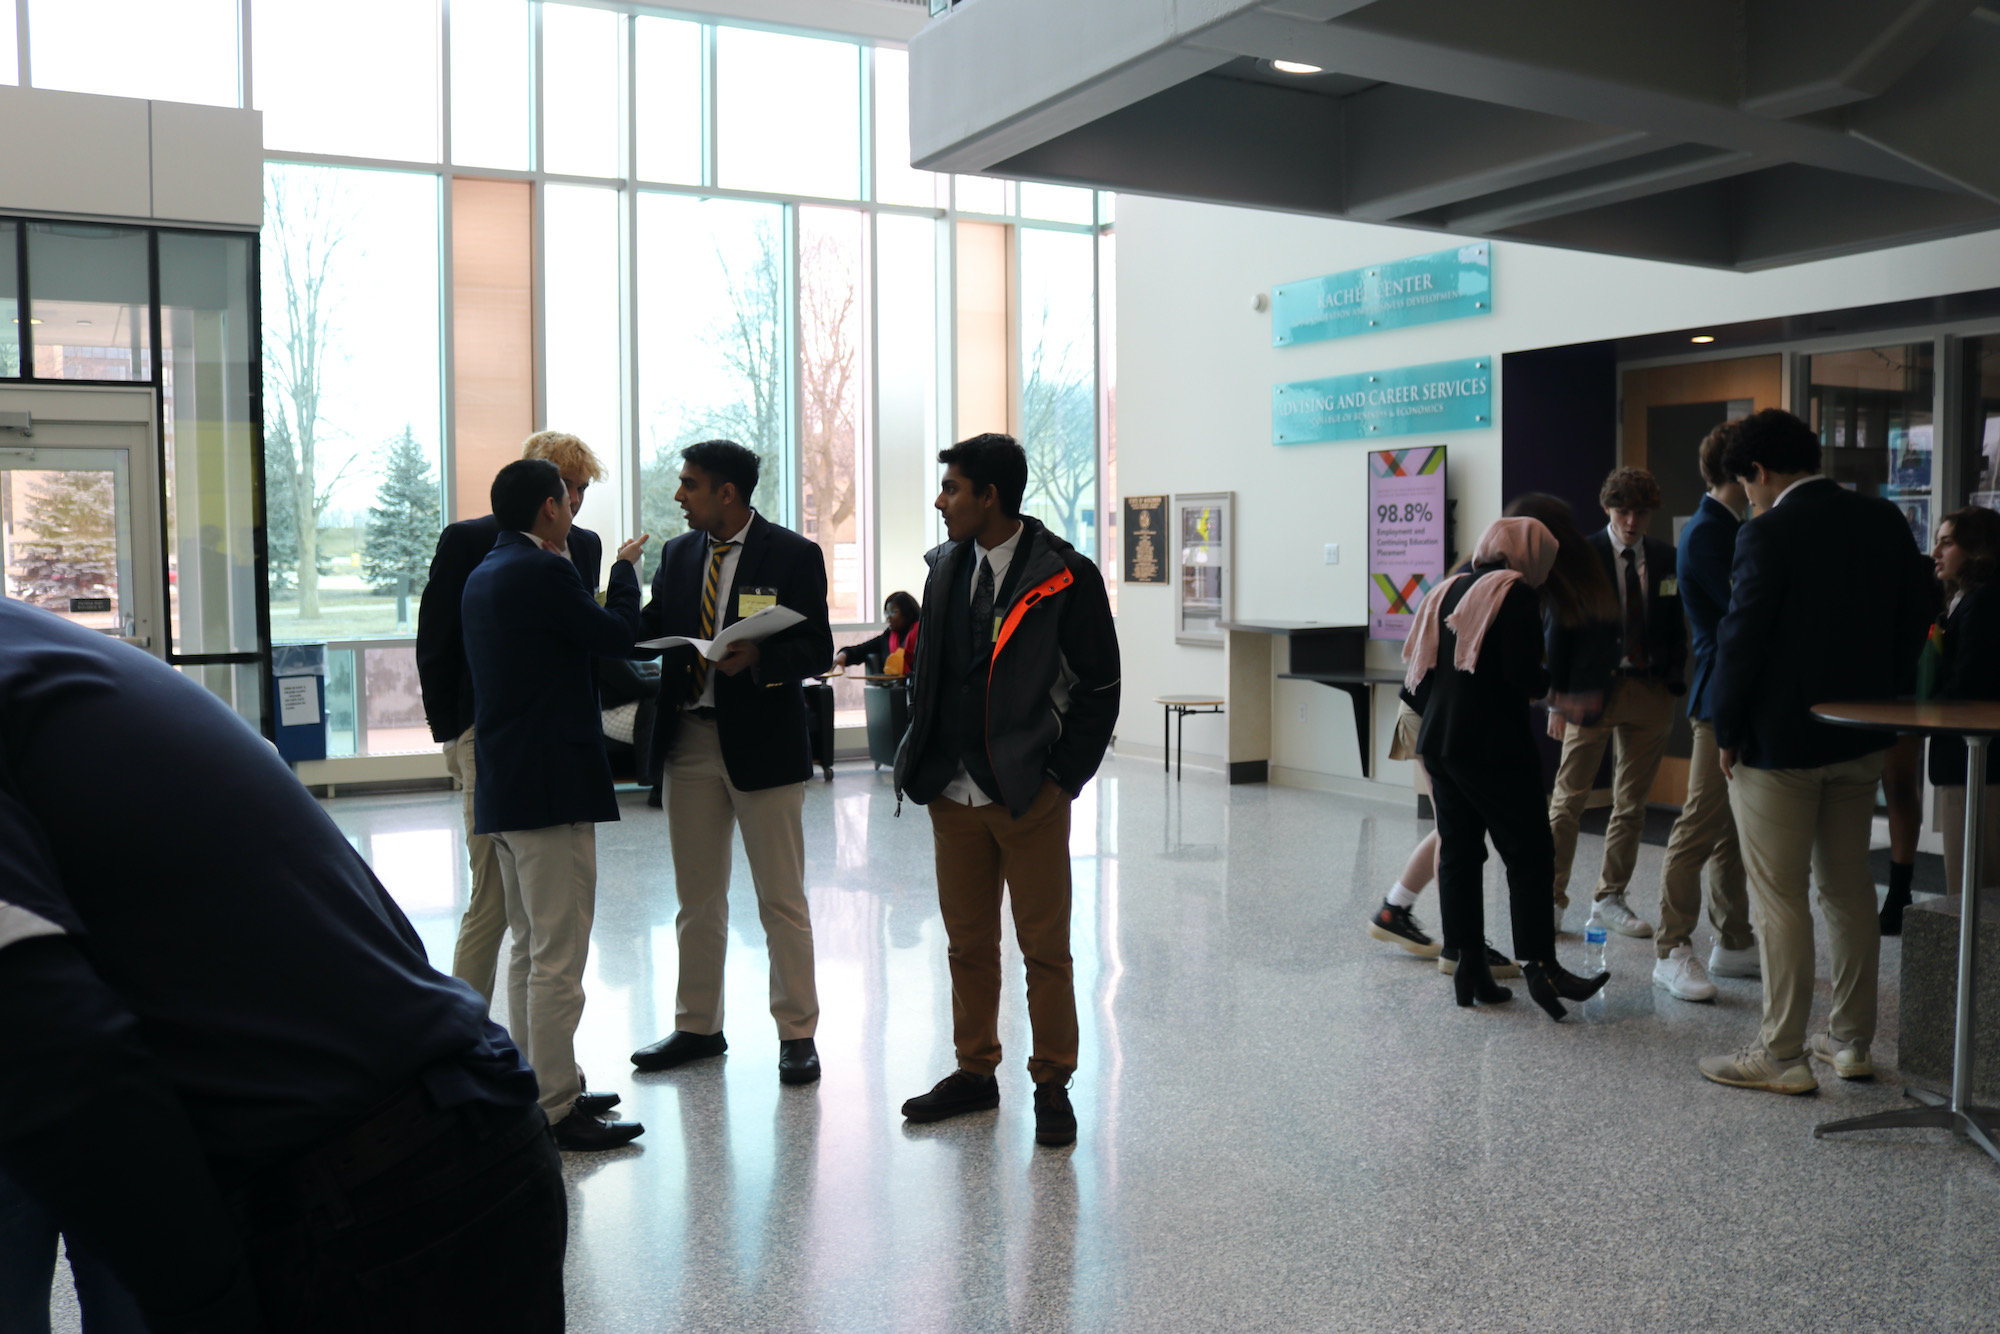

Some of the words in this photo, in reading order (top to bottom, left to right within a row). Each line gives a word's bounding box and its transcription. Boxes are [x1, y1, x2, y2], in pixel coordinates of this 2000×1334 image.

[1375, 273, 1434, 298] CENTER
[1279, 394, 1334, 416] ADVISING
[1337, 391, 1366, 410] AND
[1369, 384, 1419, 406] CAREER
[1422, 376, 1487, 400] SERVICES
[1342, 412, 1352, 421] OF
[1388, 408, 1395, 417] &
[1396, 403, 1444, 416] ECONOMICS
[1377, 502, 1433, 523] 98.8%
[1377, 527, 1412, 537] Employment
[1414, 526, 1426, 535] and
[1377, 538, 1408, 547] Continuing
[1409, 537, 1438, 545] Education
[1377, 548, 1406, 557] Placement
